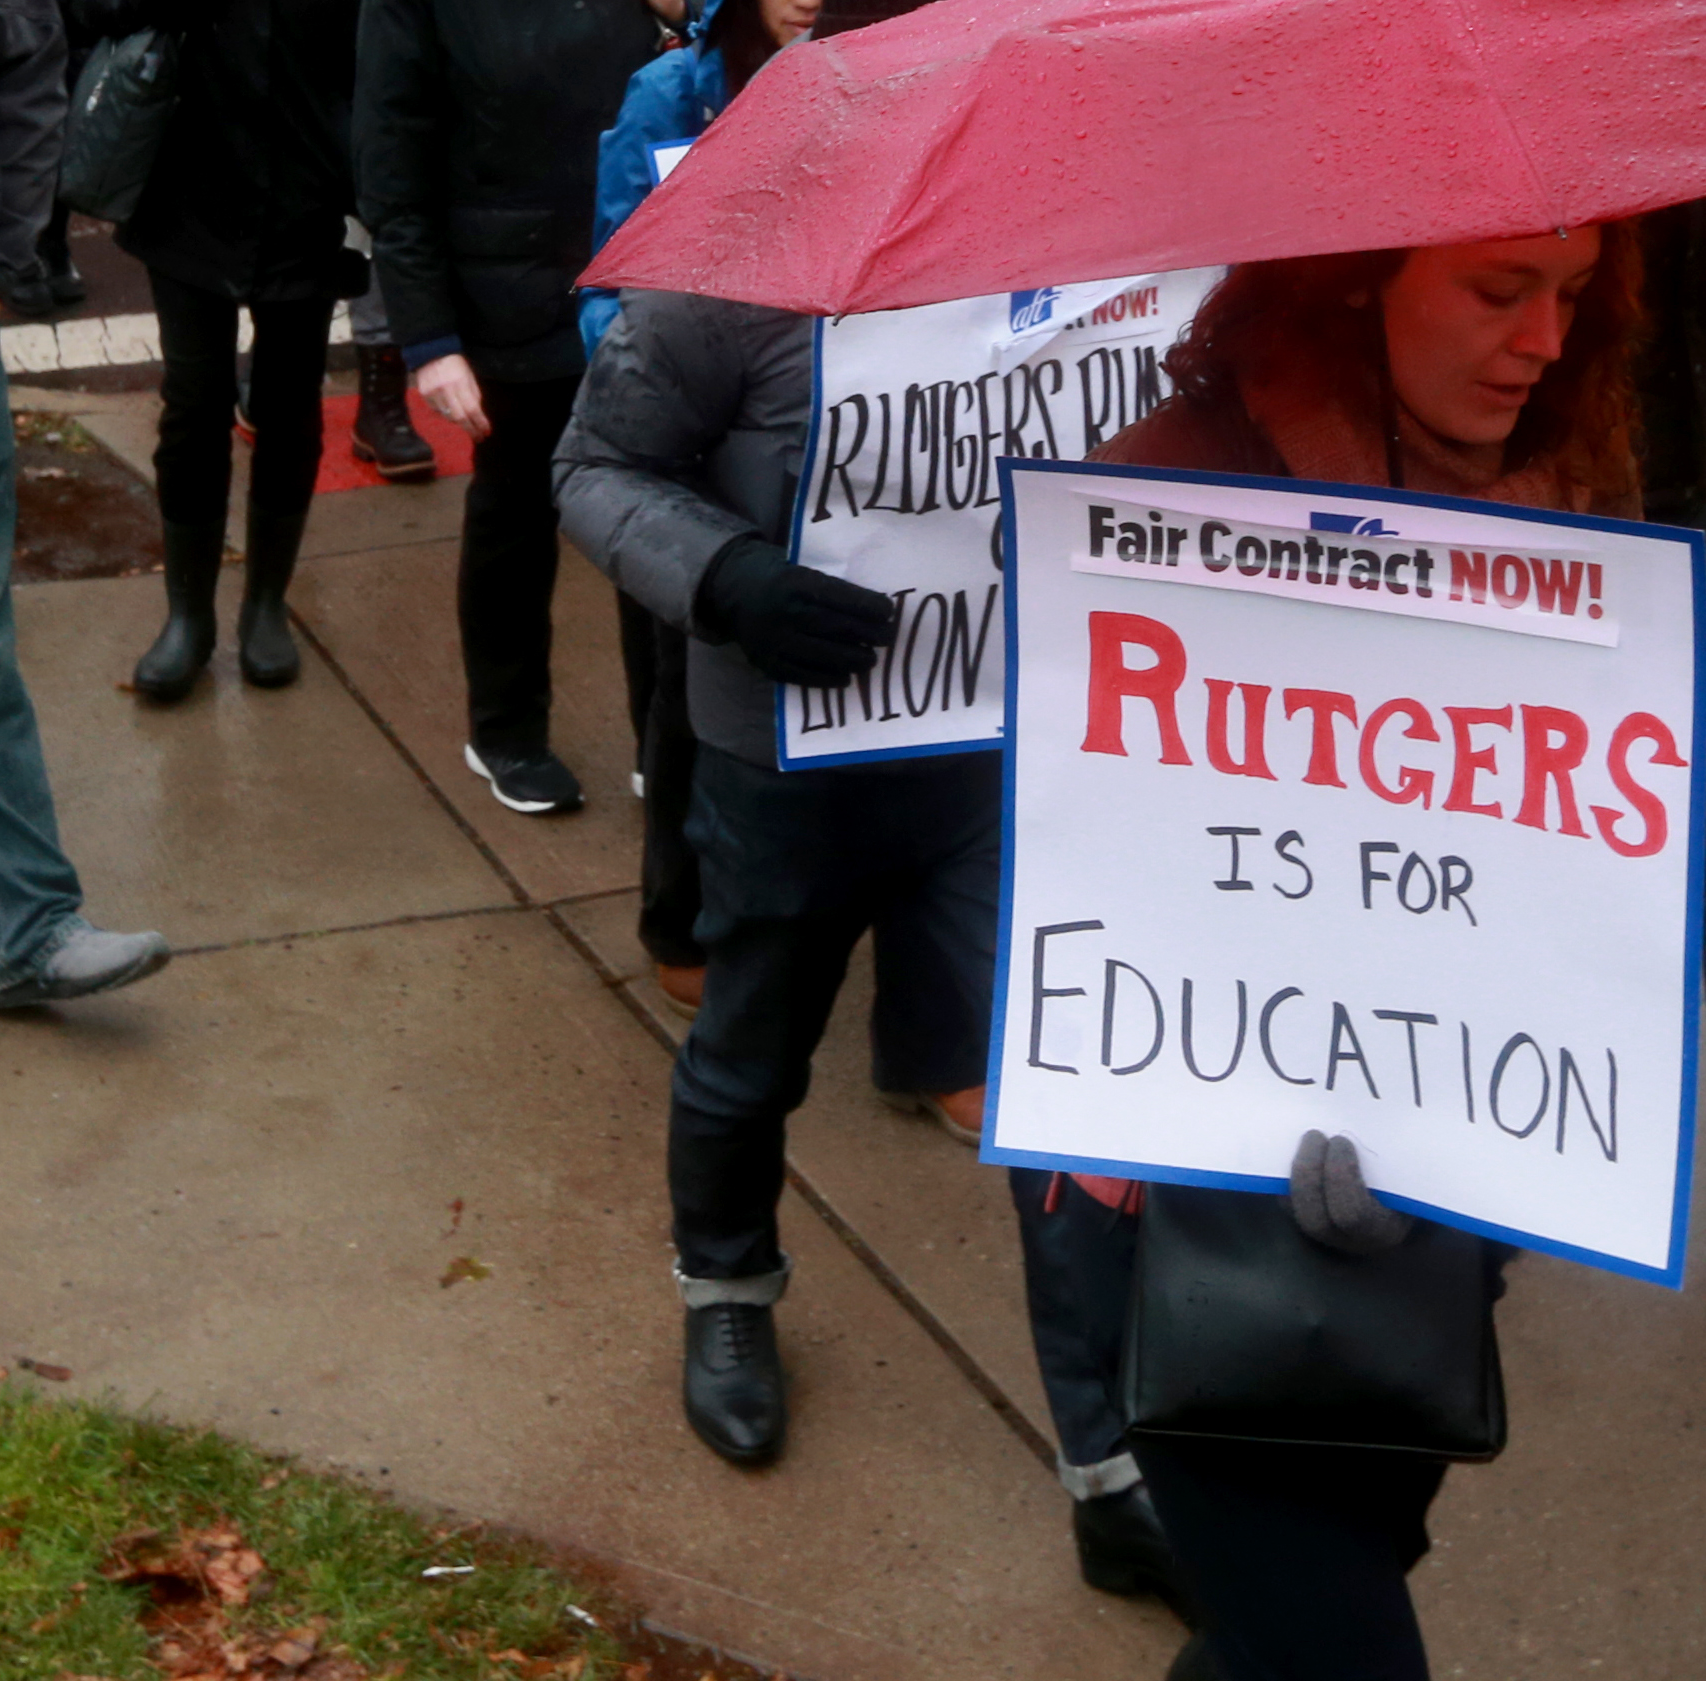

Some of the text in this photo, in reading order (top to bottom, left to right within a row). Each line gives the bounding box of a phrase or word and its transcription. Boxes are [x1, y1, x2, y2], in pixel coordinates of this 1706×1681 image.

[1091, 285, 1159, 326] NOW!
[810, 358, 1063, 523] RUTGERS
[1088, 504, 1189, 568] Fair
[1198, 520, 1435, 599] Contract
[1448, 550, 1605, 621] NOW!
[1079, 610, 1689, 858] RUTGERS
[1205, 825, 1478, 927] IS FOR
[1026, 919, 1619, 1163] EDUCATION
